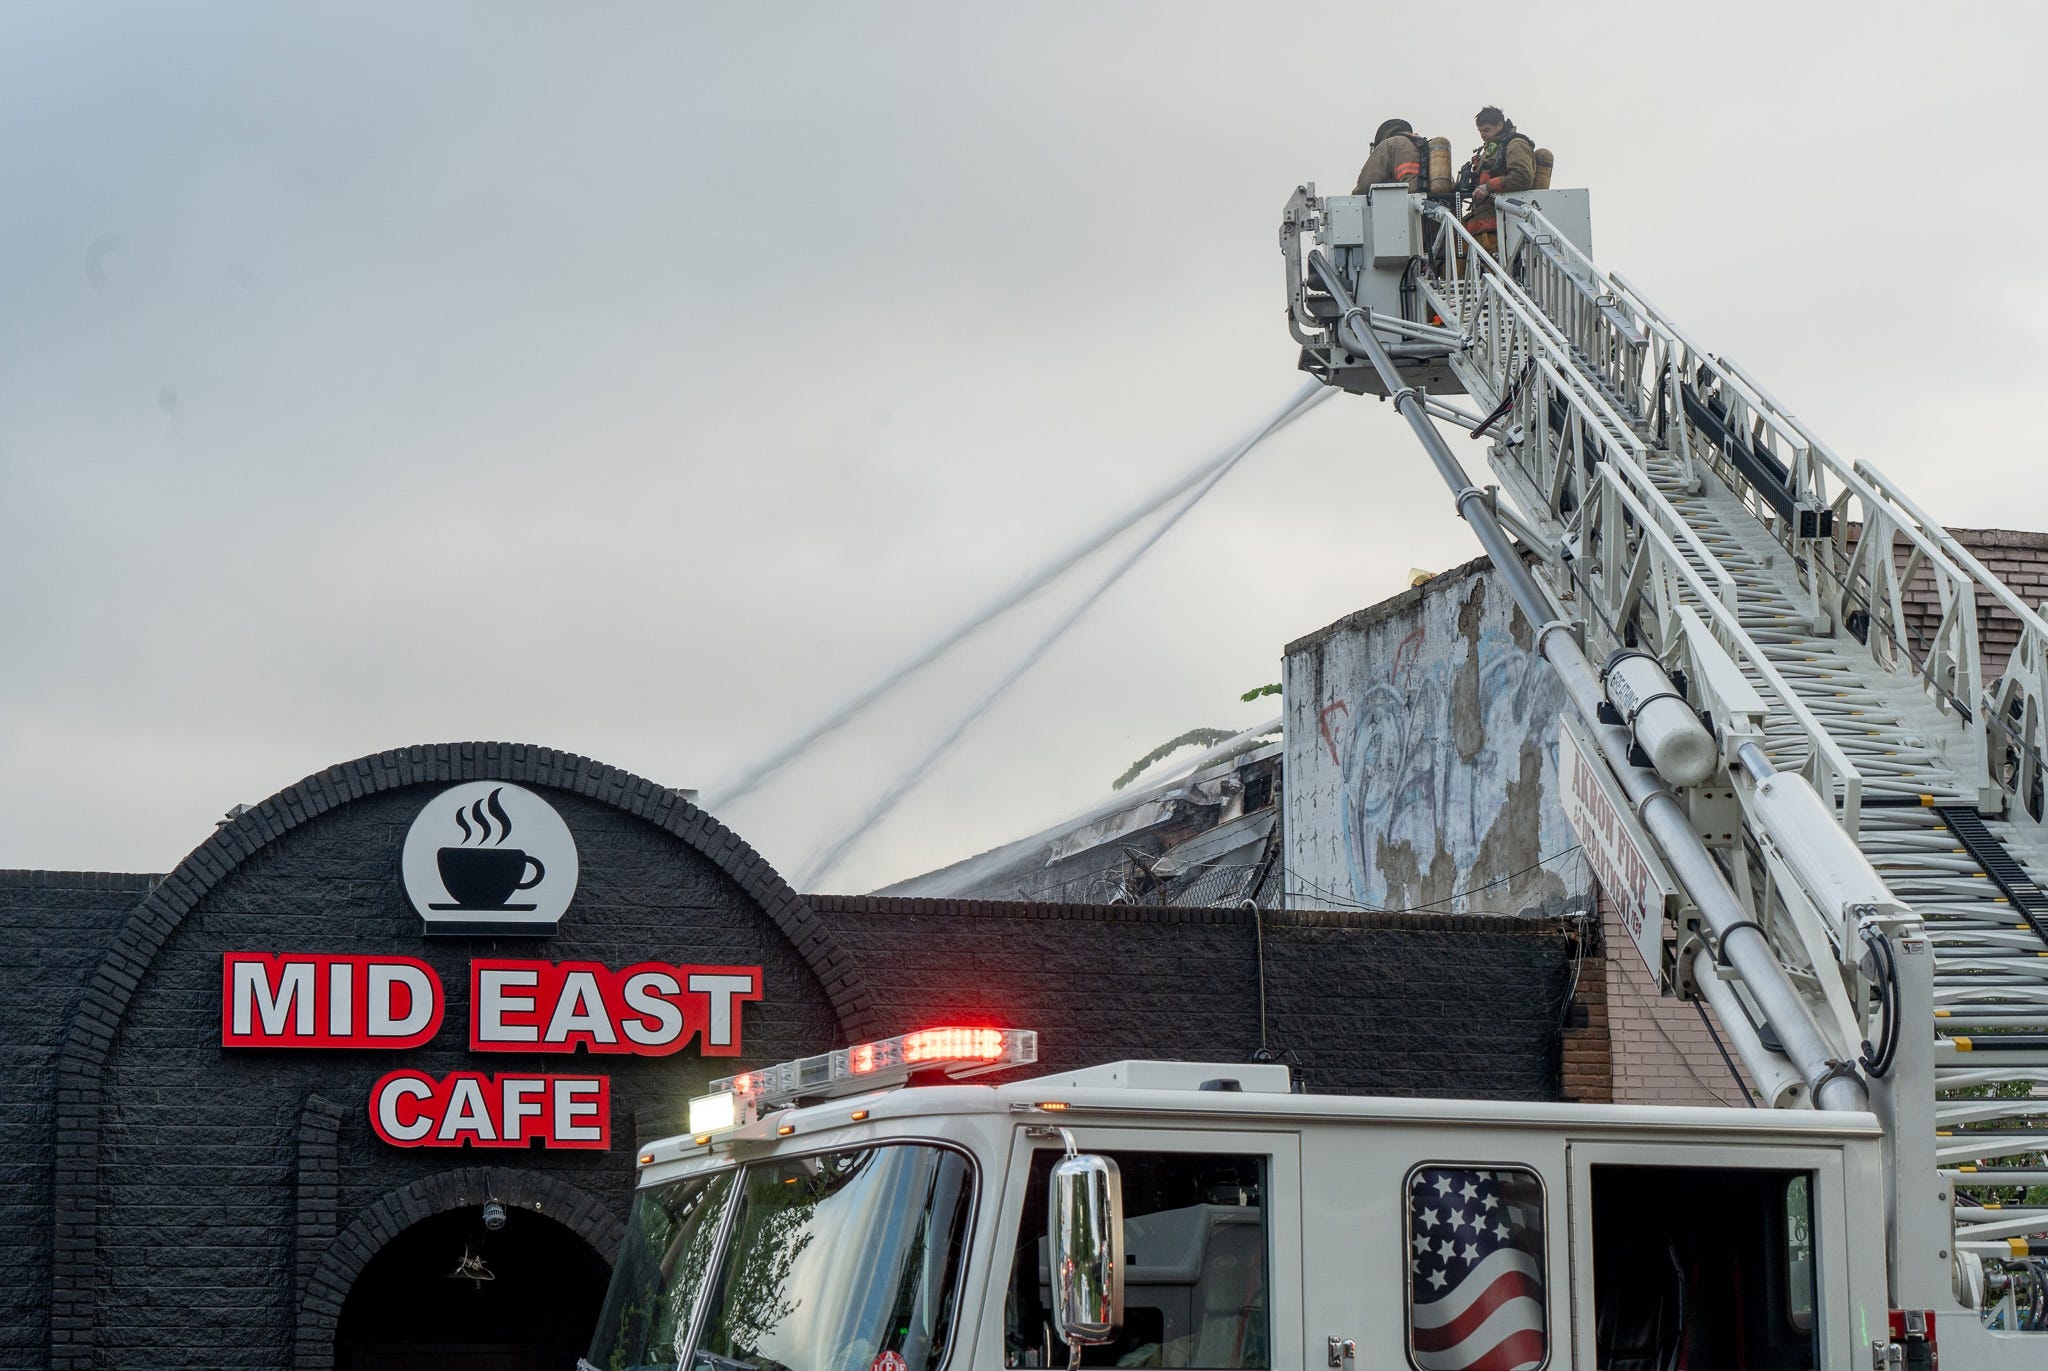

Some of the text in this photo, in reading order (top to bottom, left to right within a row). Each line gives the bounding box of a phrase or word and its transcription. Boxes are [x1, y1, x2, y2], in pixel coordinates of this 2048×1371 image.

[1572, 751, 1647, 920] AKRON FIRE
[1582, 812, 1631, 926] DEPARTMENT
[232, 961, 752, 1047] MID EAST
[378, 1077, 602, 1142] CAFE
